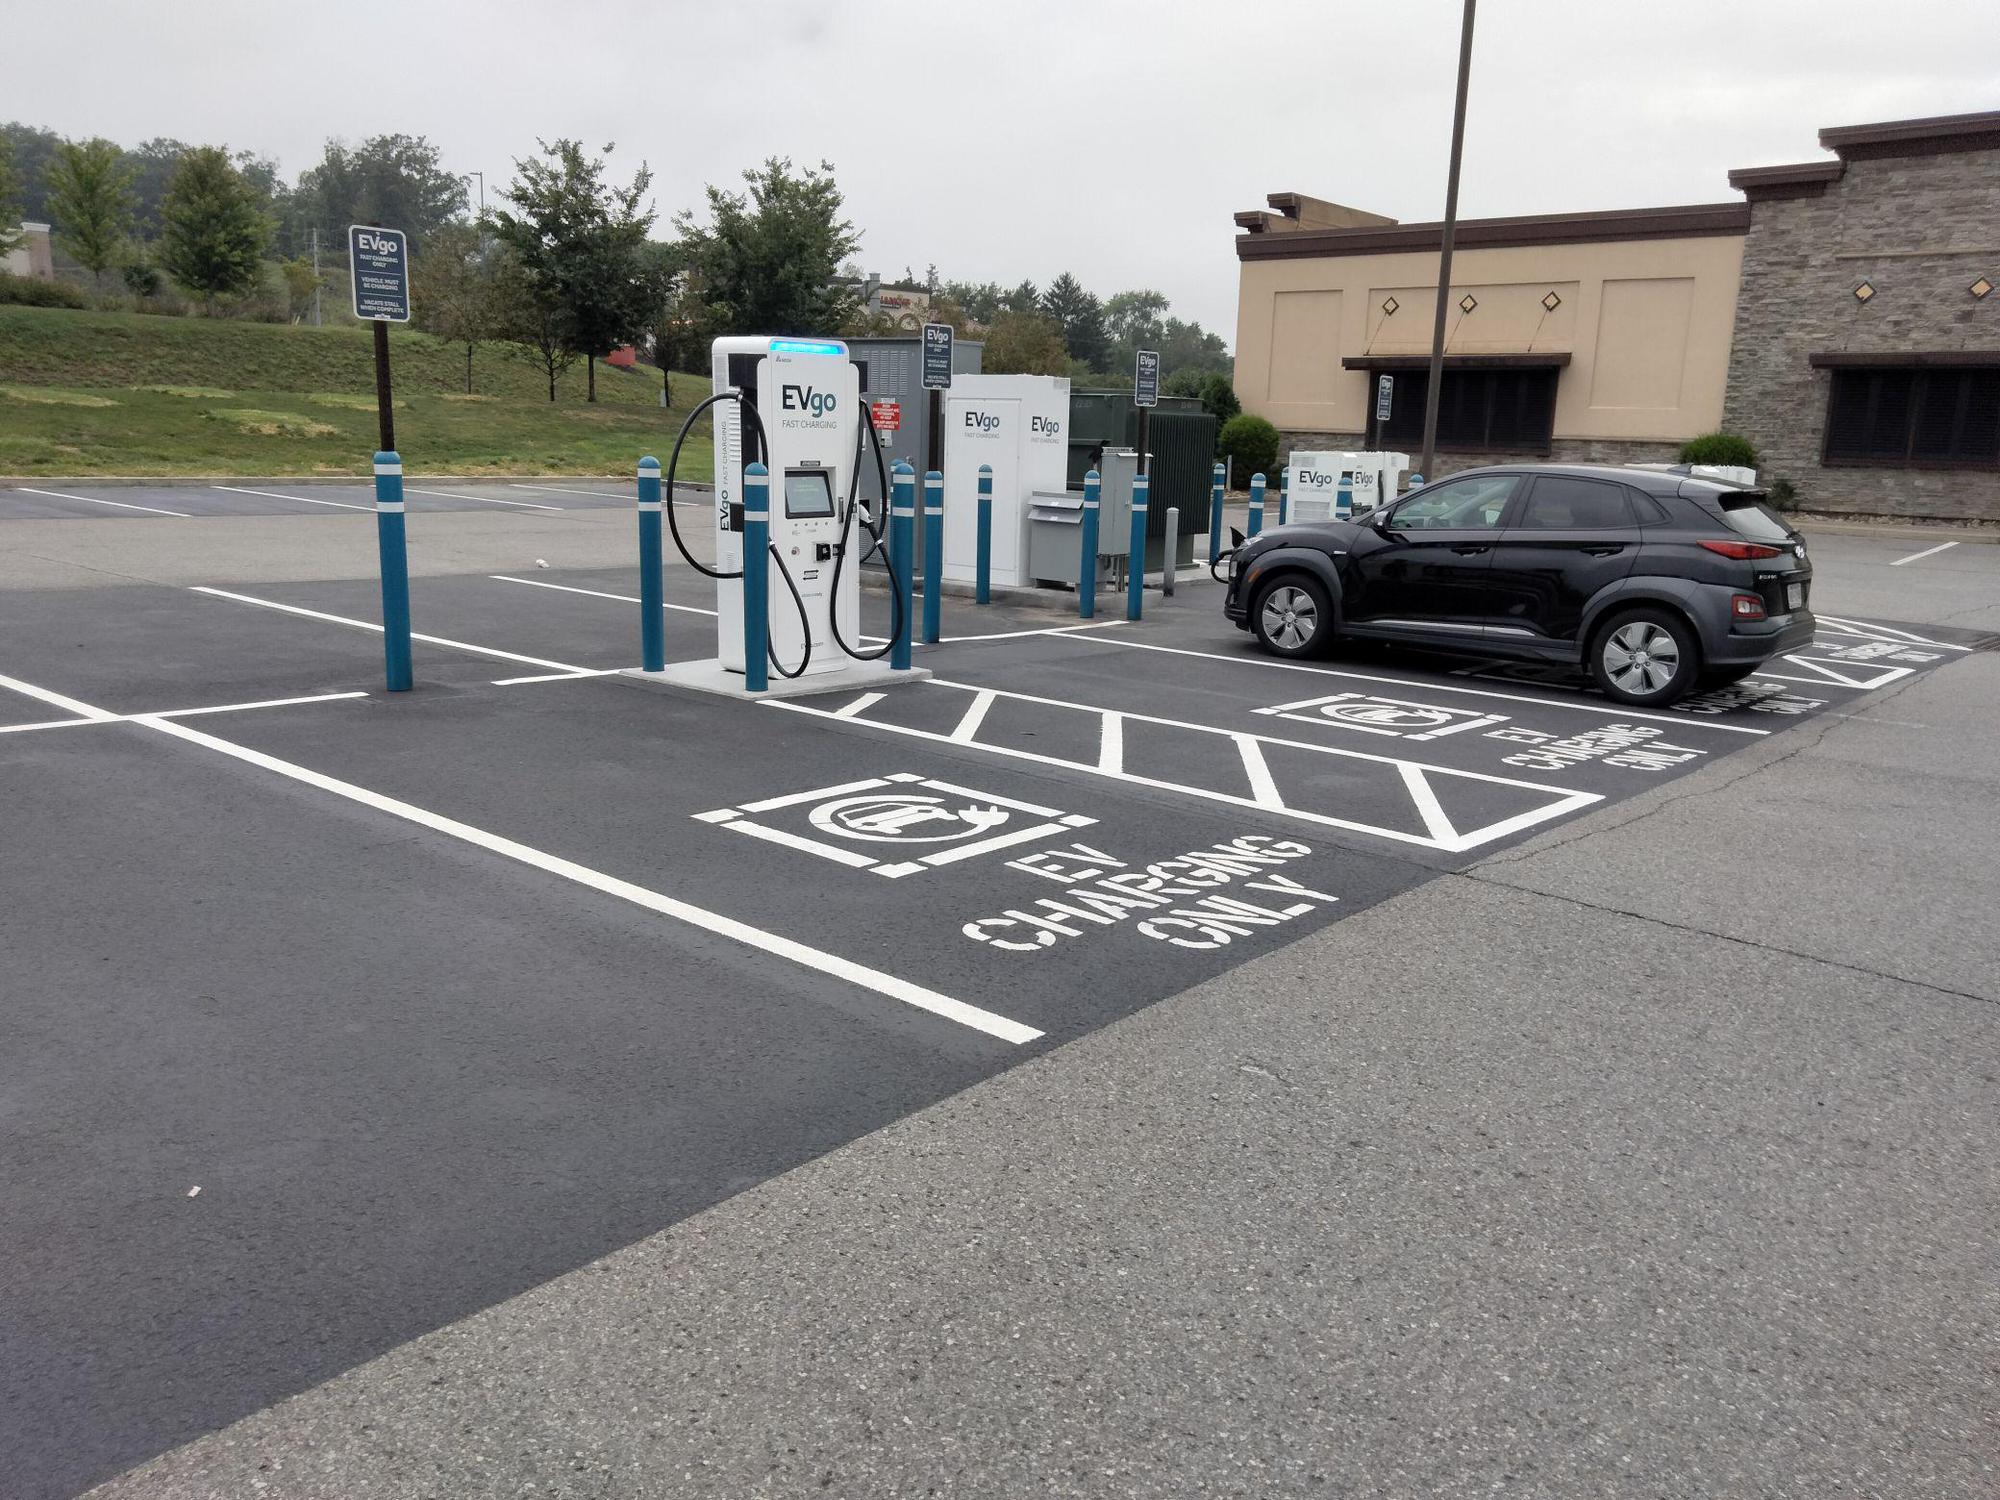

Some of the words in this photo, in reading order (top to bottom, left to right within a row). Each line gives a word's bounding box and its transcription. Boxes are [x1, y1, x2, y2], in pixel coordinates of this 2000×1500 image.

[358, 233, 398, 255] EVgo
[371, 283, 399, 291] CHARGING
[927, 327, 949, 343] EVgo
[782, 384, 836, 418] EVgo
[782, 420, 799, 428] FAST
[801, 420, 837, 429] CHARGING
[965, 412, 1000, 432] EVgo
[1032, 416, 1060, 437] EVgo
[1299, 470, 1332, 487] EVgo
[1355, 472, 1374, 487] EVgo
[720, 490, 730, 531] EVgo
[1482, 727, 1558, 744] EV
[1501, 724, 1664, 770] CHARGING
[1602, 741, 1708, 771] ONLY
[1003, 843, 1128, 884] EV
[961, 835, 1312, 951] CHARGING
[1136, 874, 1340, 949] ONLY
